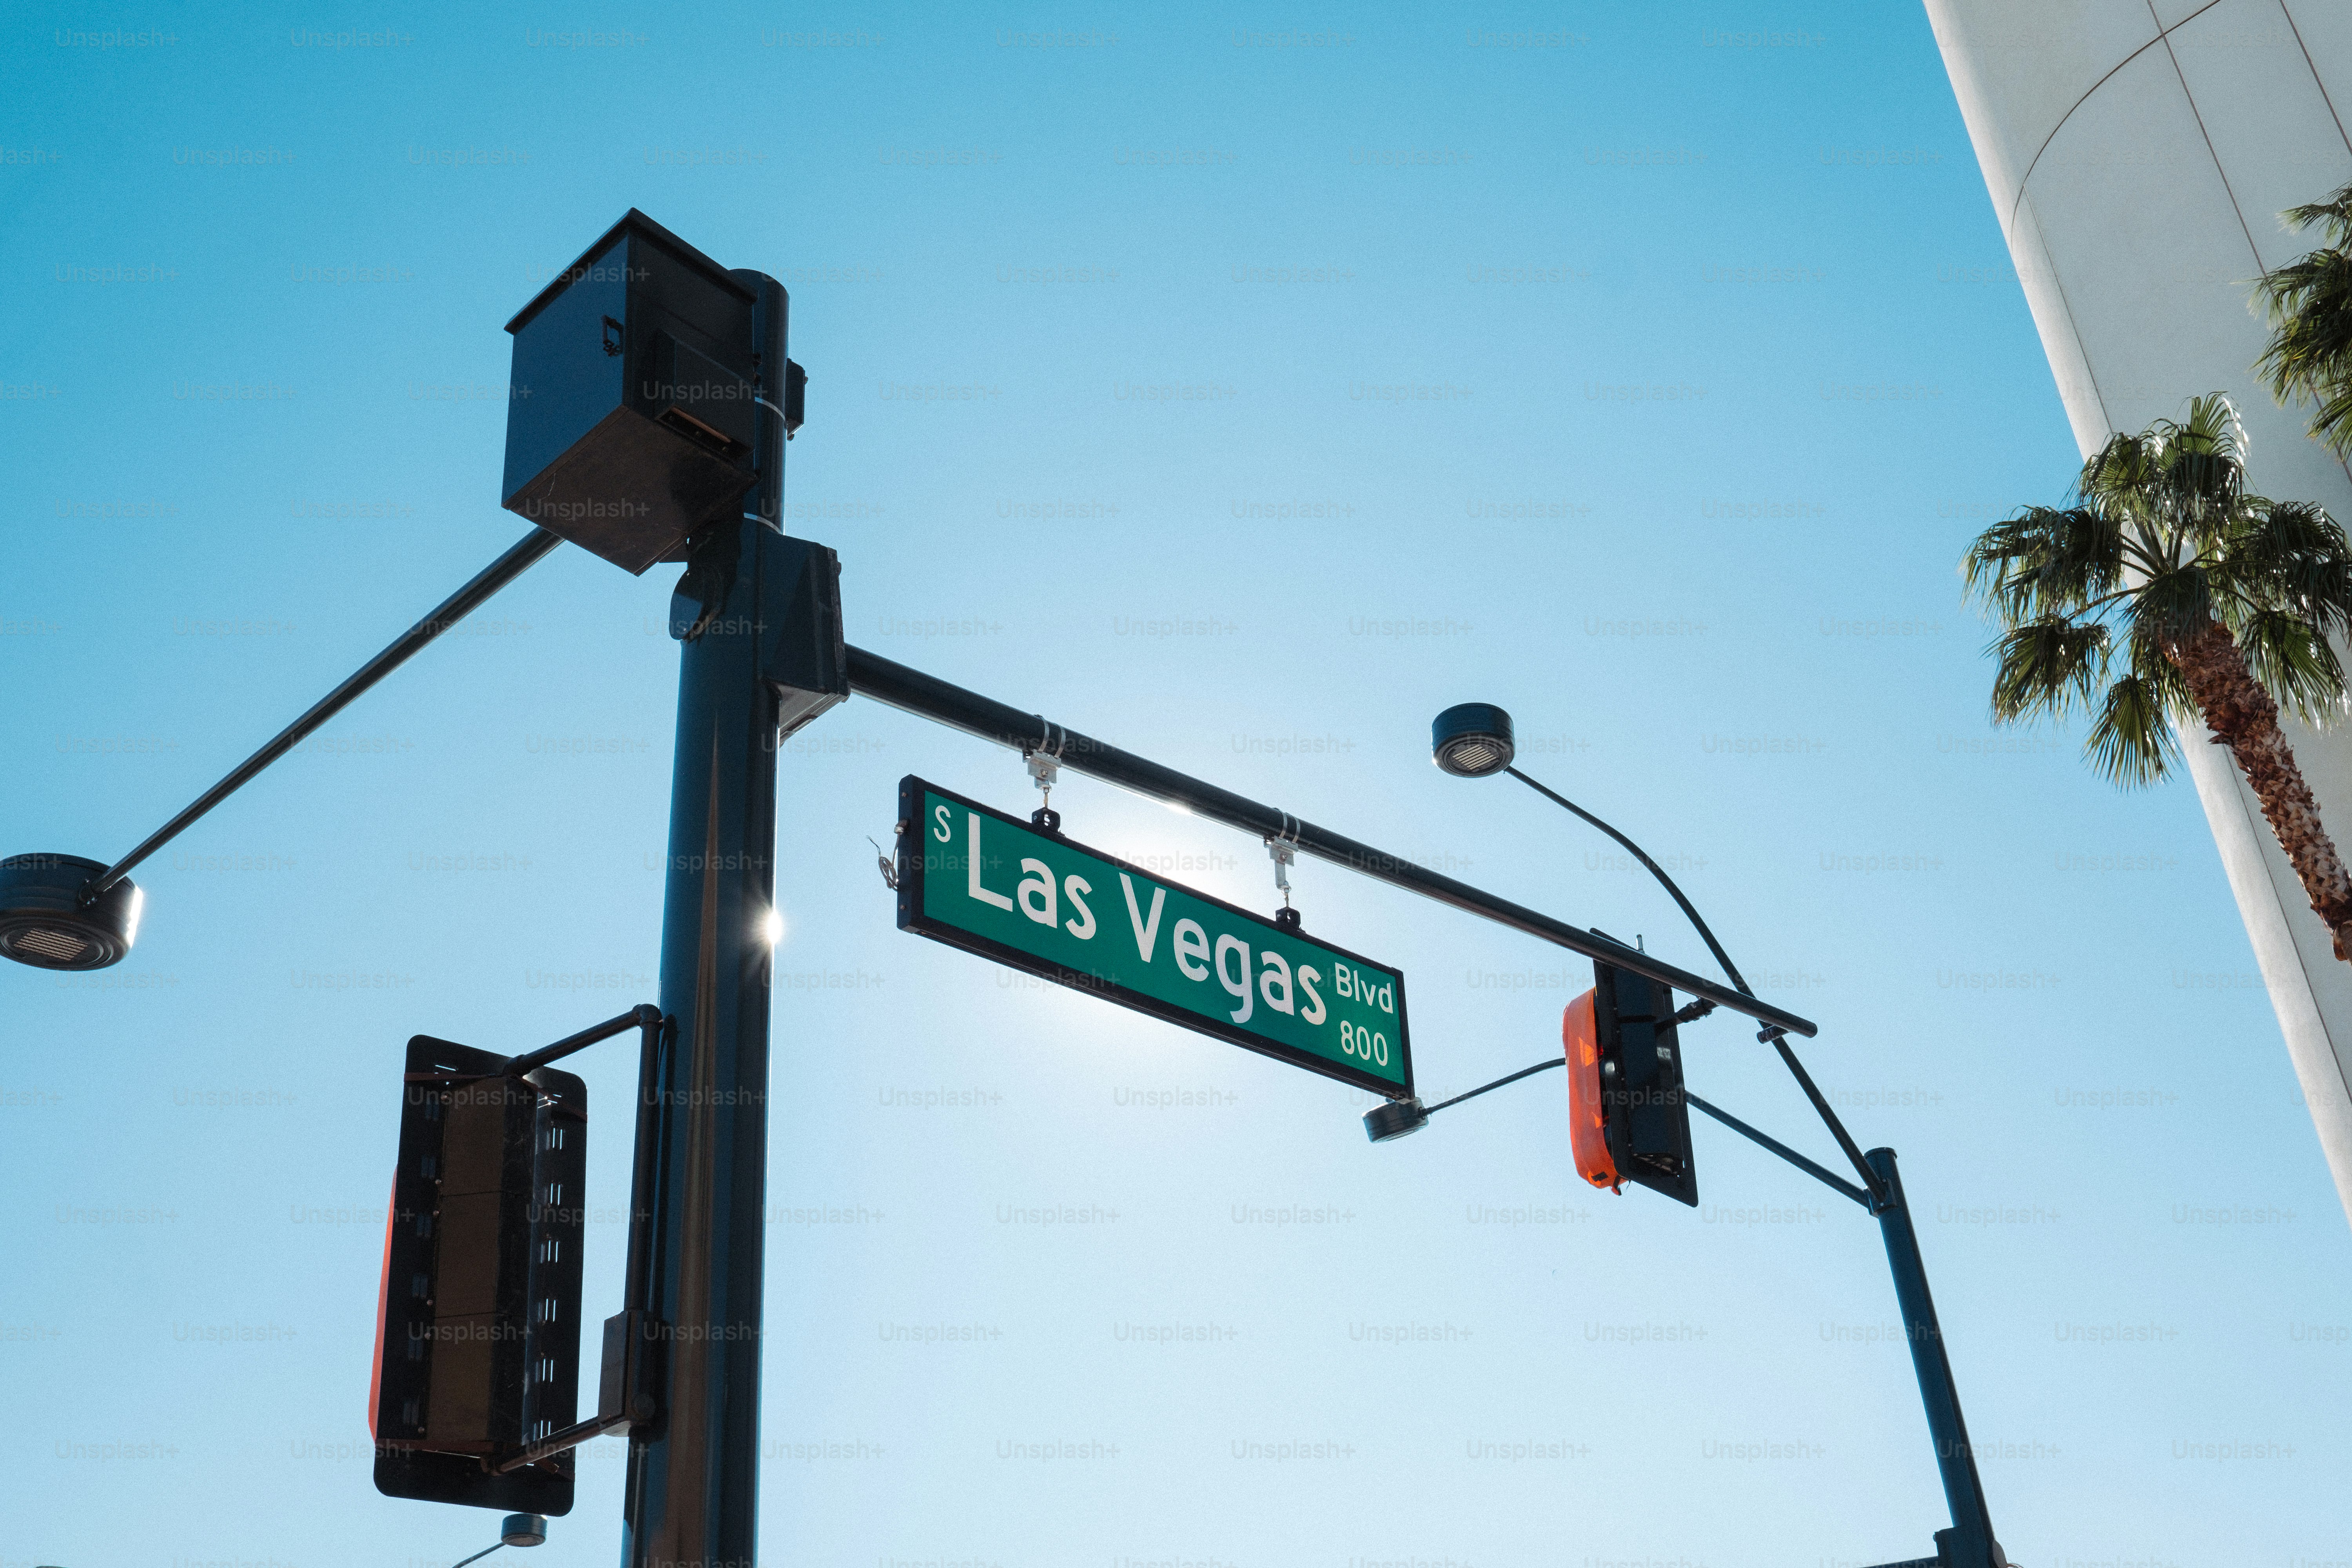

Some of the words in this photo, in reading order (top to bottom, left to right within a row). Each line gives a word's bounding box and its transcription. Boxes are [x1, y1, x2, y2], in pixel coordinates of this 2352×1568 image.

[933, 805, 951, 843] S
[968, 812, 1097, 940] Las
[1119, 872, 1327, 1025] Vegas
[1334, 962, 1394, 1014] Blvd
[1340, 1020, 1388, 1067] 800
